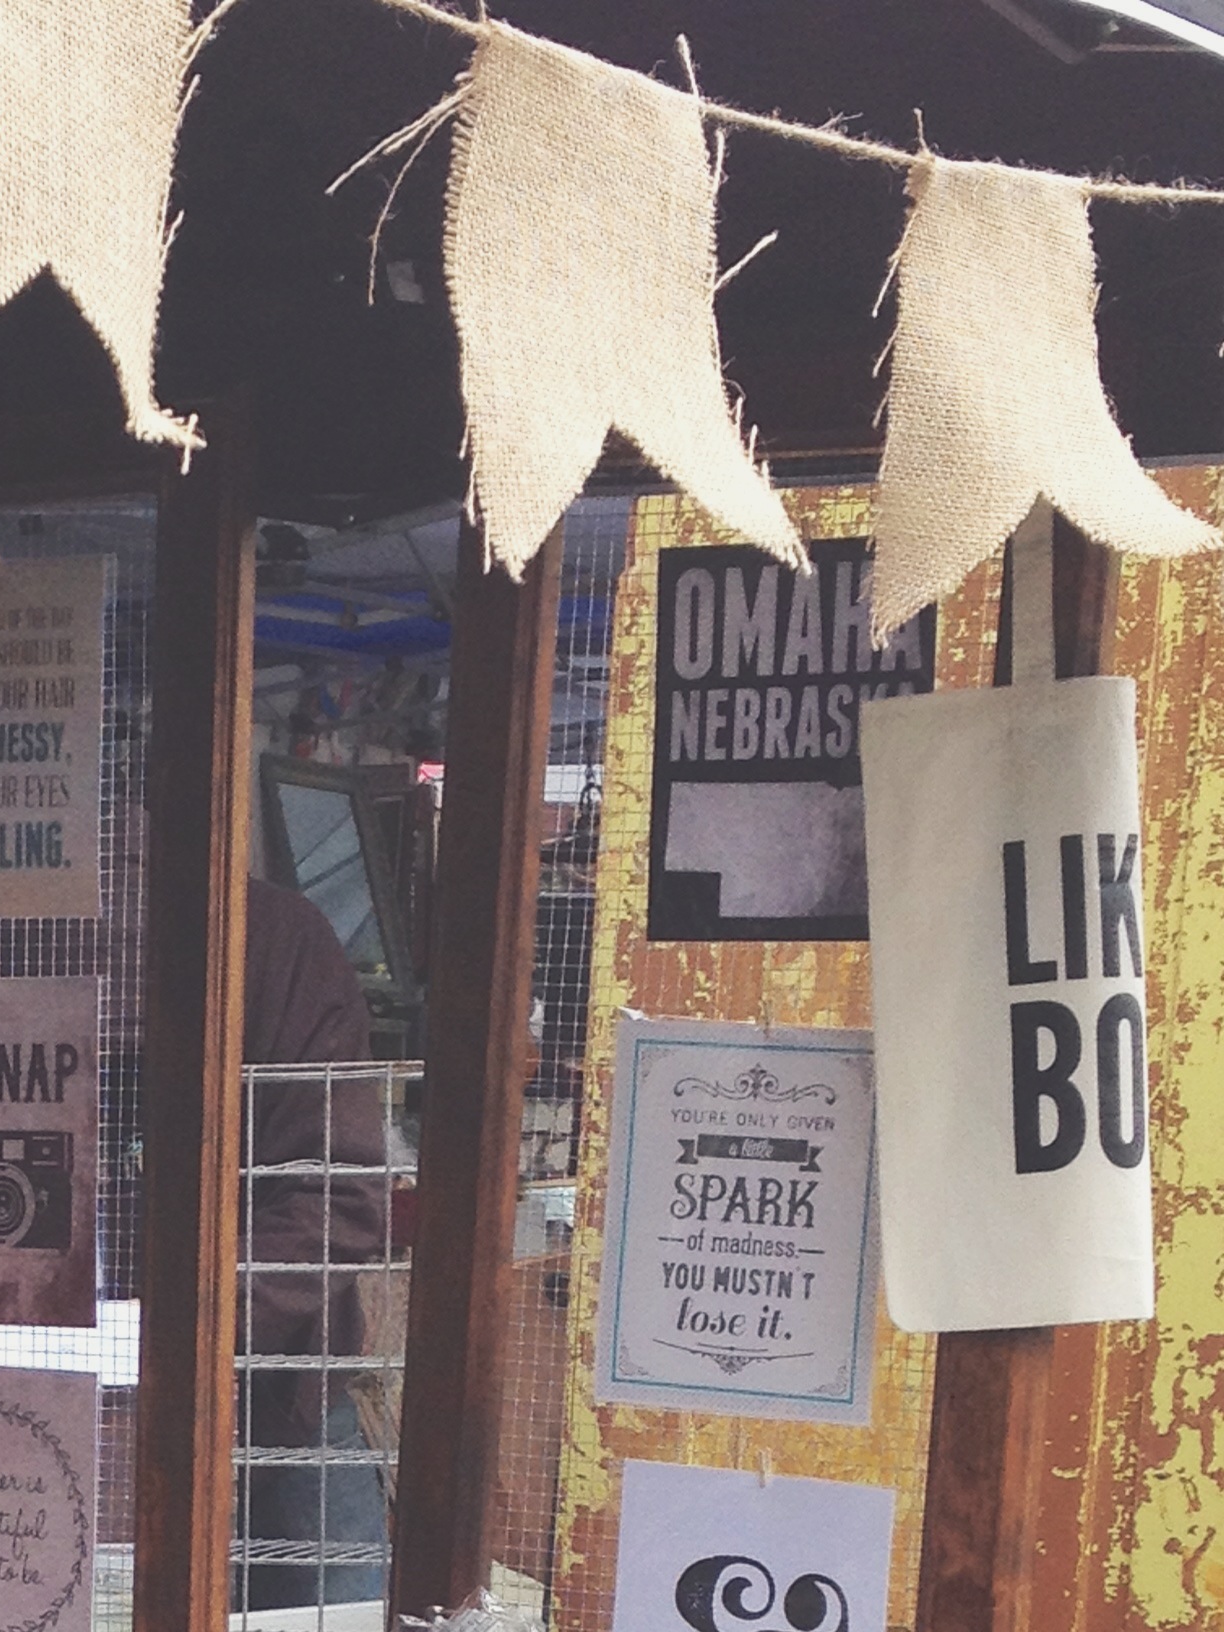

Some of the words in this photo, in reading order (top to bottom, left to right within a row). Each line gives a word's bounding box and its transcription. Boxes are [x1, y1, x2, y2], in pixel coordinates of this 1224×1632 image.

[674, 561, 922, 680] OMAHA
[35, 677, 75, 708] HAIR
[24, 773, 70, 808] EYES
[736, 1110, 780, 1129] ONLY
[787, 1115, 836, 1132] GIVEN
[670, 1171, 819, 1229] SPARK
[687, 1228, 704, 1252] of
[662, 1261, 704, 1291] YOU
[676, 1298, 747, 1335] lose
[758, 1305, 792, 1340] it.
[25, 1474, 46, 1494] is
